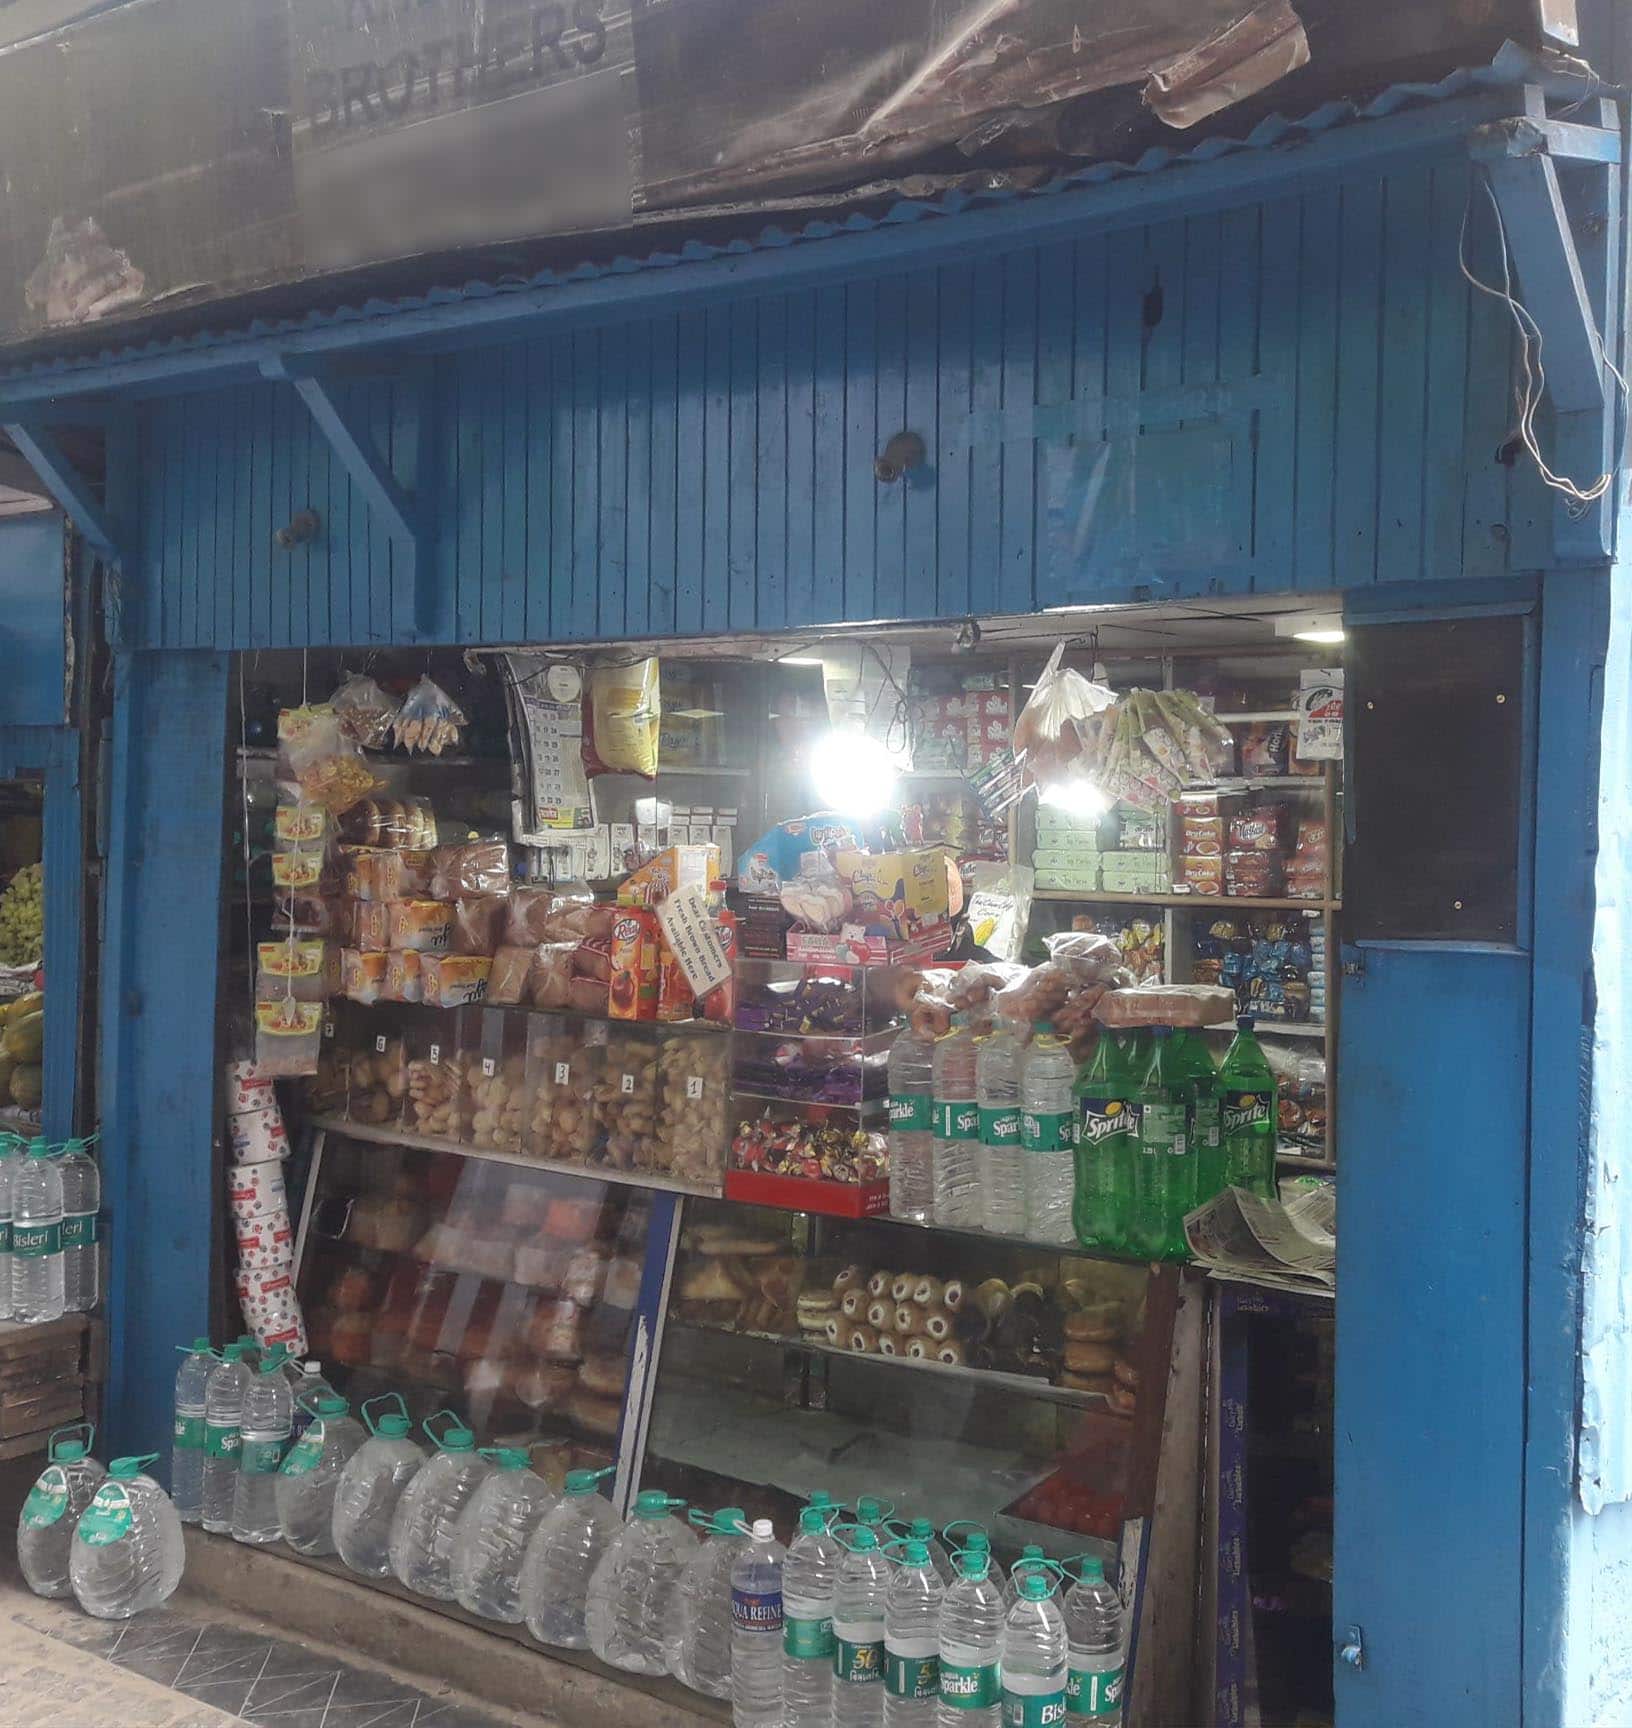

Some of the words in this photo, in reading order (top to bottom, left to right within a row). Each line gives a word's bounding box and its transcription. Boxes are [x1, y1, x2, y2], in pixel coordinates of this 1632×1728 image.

[674, 899, 686, 925] Fresh
[685, 925, 700, 954] Brown
[700, 955, 715, 982] Bread
[688, 897, 700, 920] Dear
[700, 920, 722, 969] Customers
[667, 916, 687, 957] Available
[685, 957, 698, 979] Here
[890, 1102, 913, 1120] arkle
[1087, 1108, 1135, 1138] Sprite
[1224, 1102, 1265, 1127] Sprite
[993, 1119, 1018, 1137] Spar
[13, 1230, 48, 1248] Bisleri
[62, 1220, 82, 1235] leri
[1041, 1697, 1066, 1725] Bisl
